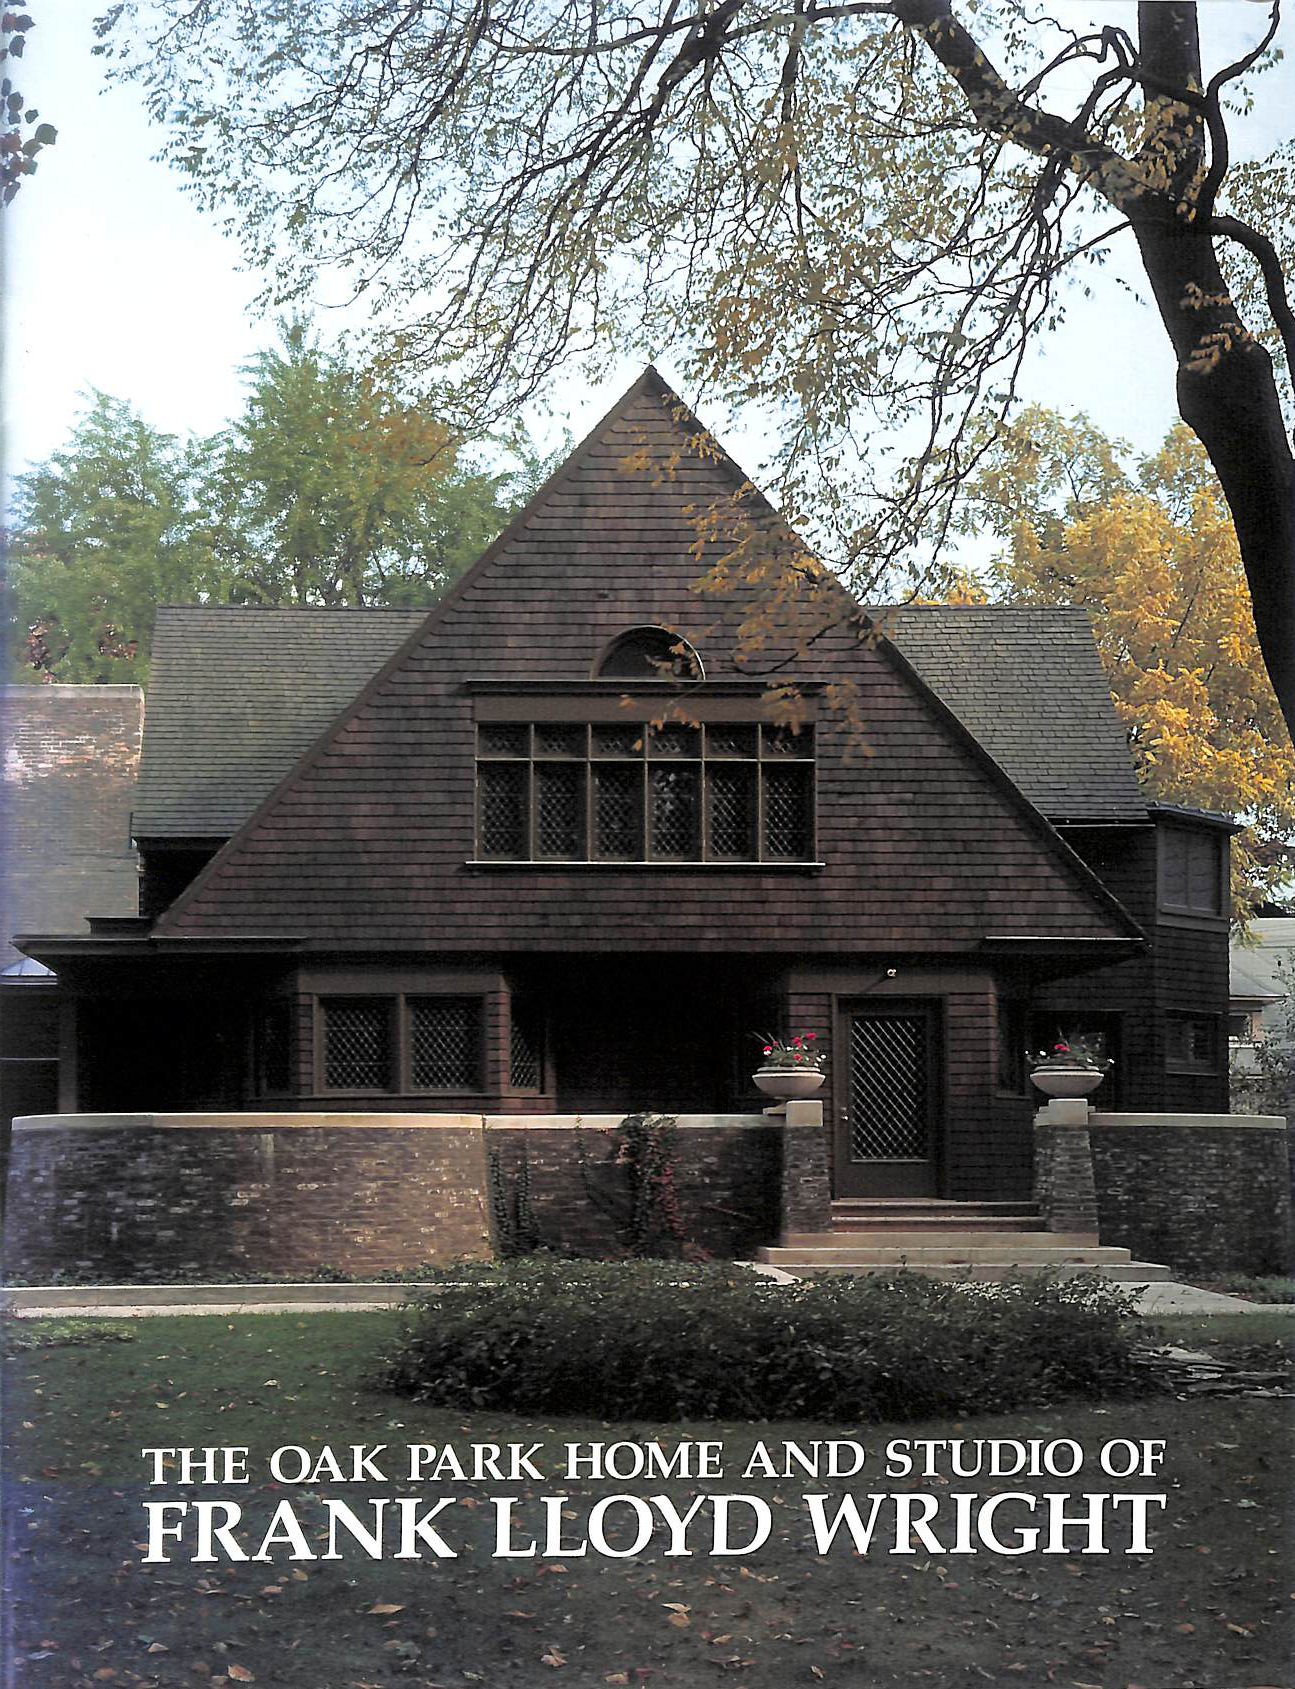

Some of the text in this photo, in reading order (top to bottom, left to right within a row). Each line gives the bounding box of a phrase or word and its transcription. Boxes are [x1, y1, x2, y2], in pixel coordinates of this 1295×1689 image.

[141, 1438, 1167, 1485] THE OAK PARK HOME AND STUDIO OF
[141, 1492, 1168, 1563] FRANK LLOYD WRIGHT
